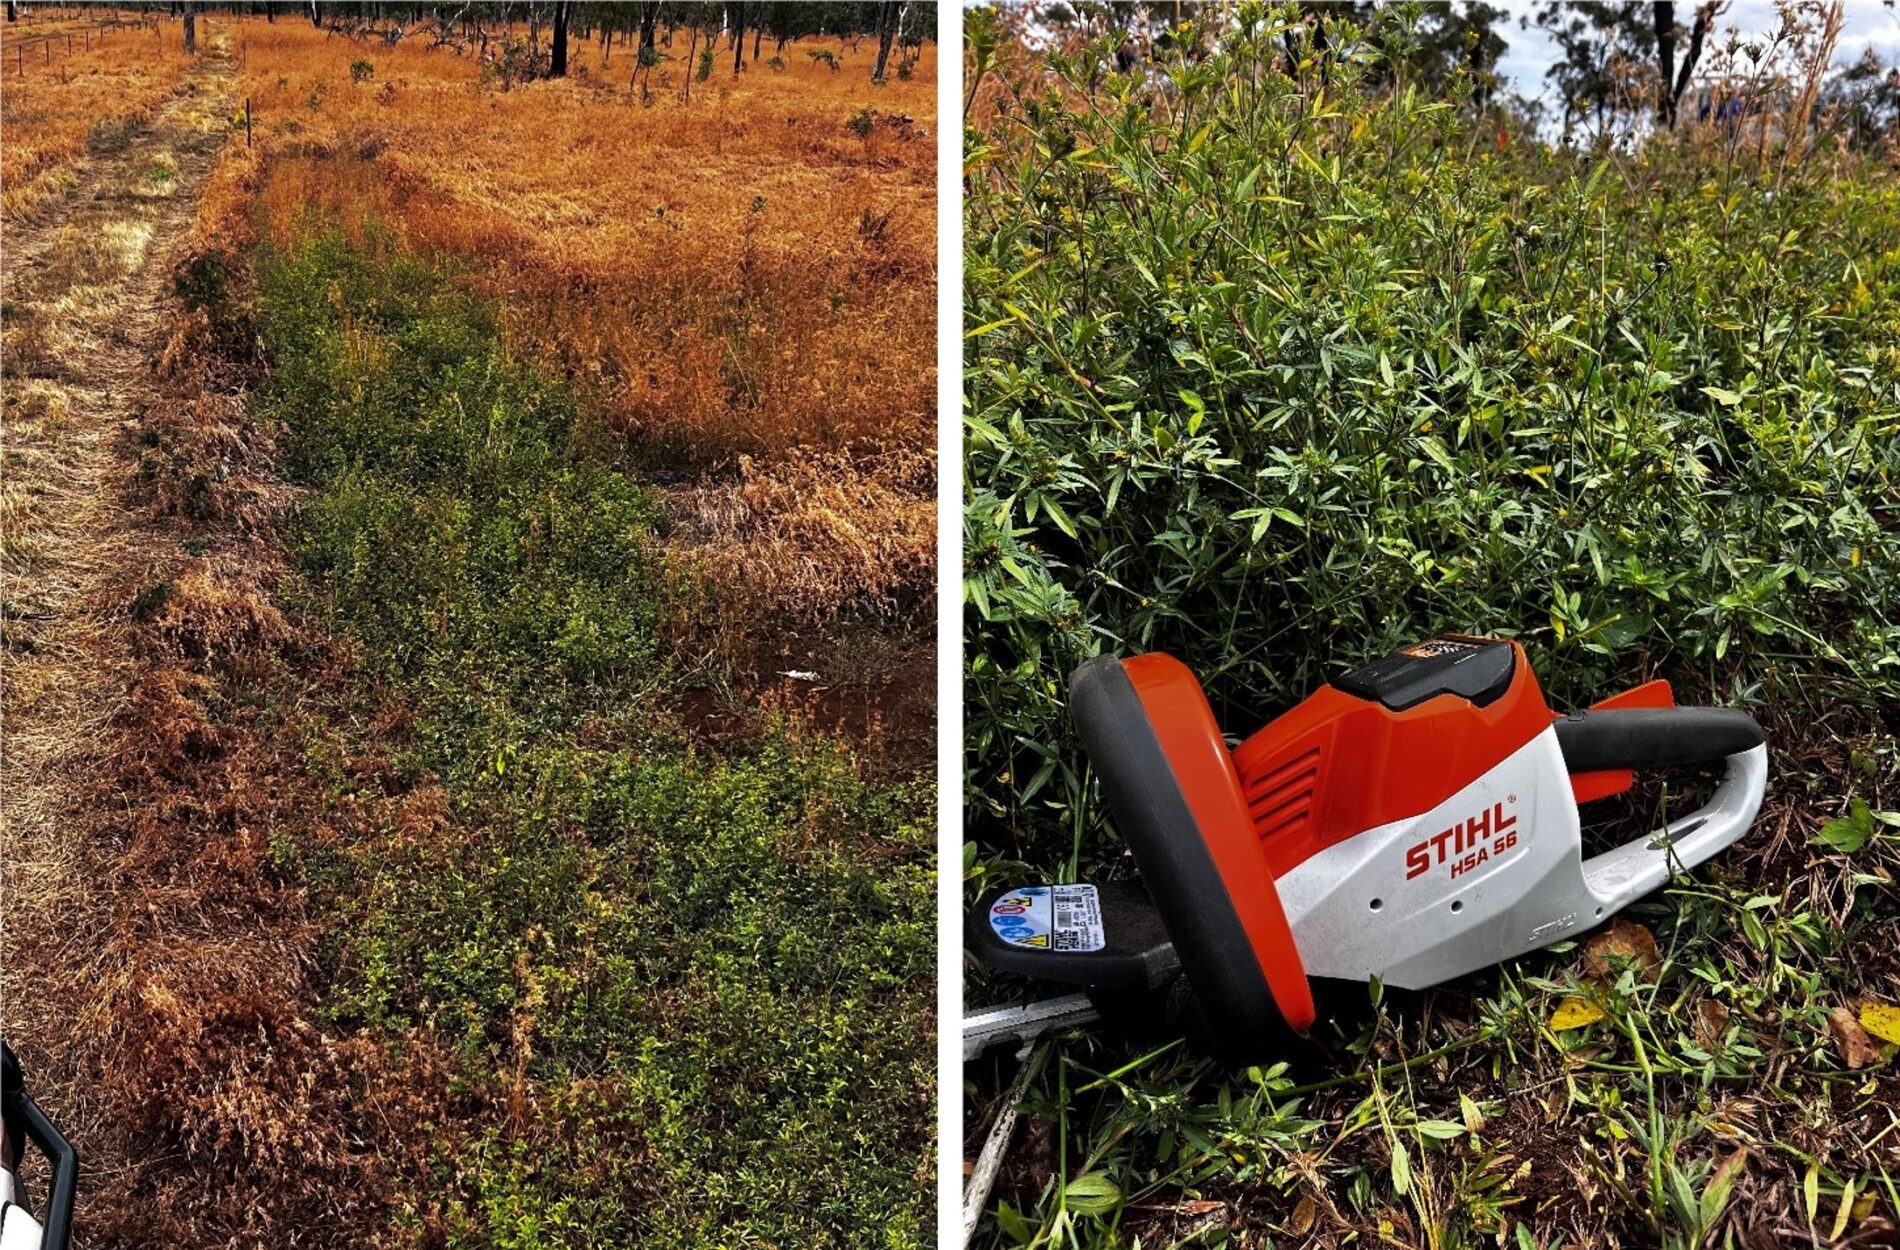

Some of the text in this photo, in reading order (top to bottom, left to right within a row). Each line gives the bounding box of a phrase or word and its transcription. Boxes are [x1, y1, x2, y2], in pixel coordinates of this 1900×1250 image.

[1406, 802, 1517, 881] STIHL
[1451, 830, 1517, 880] HSA 56
